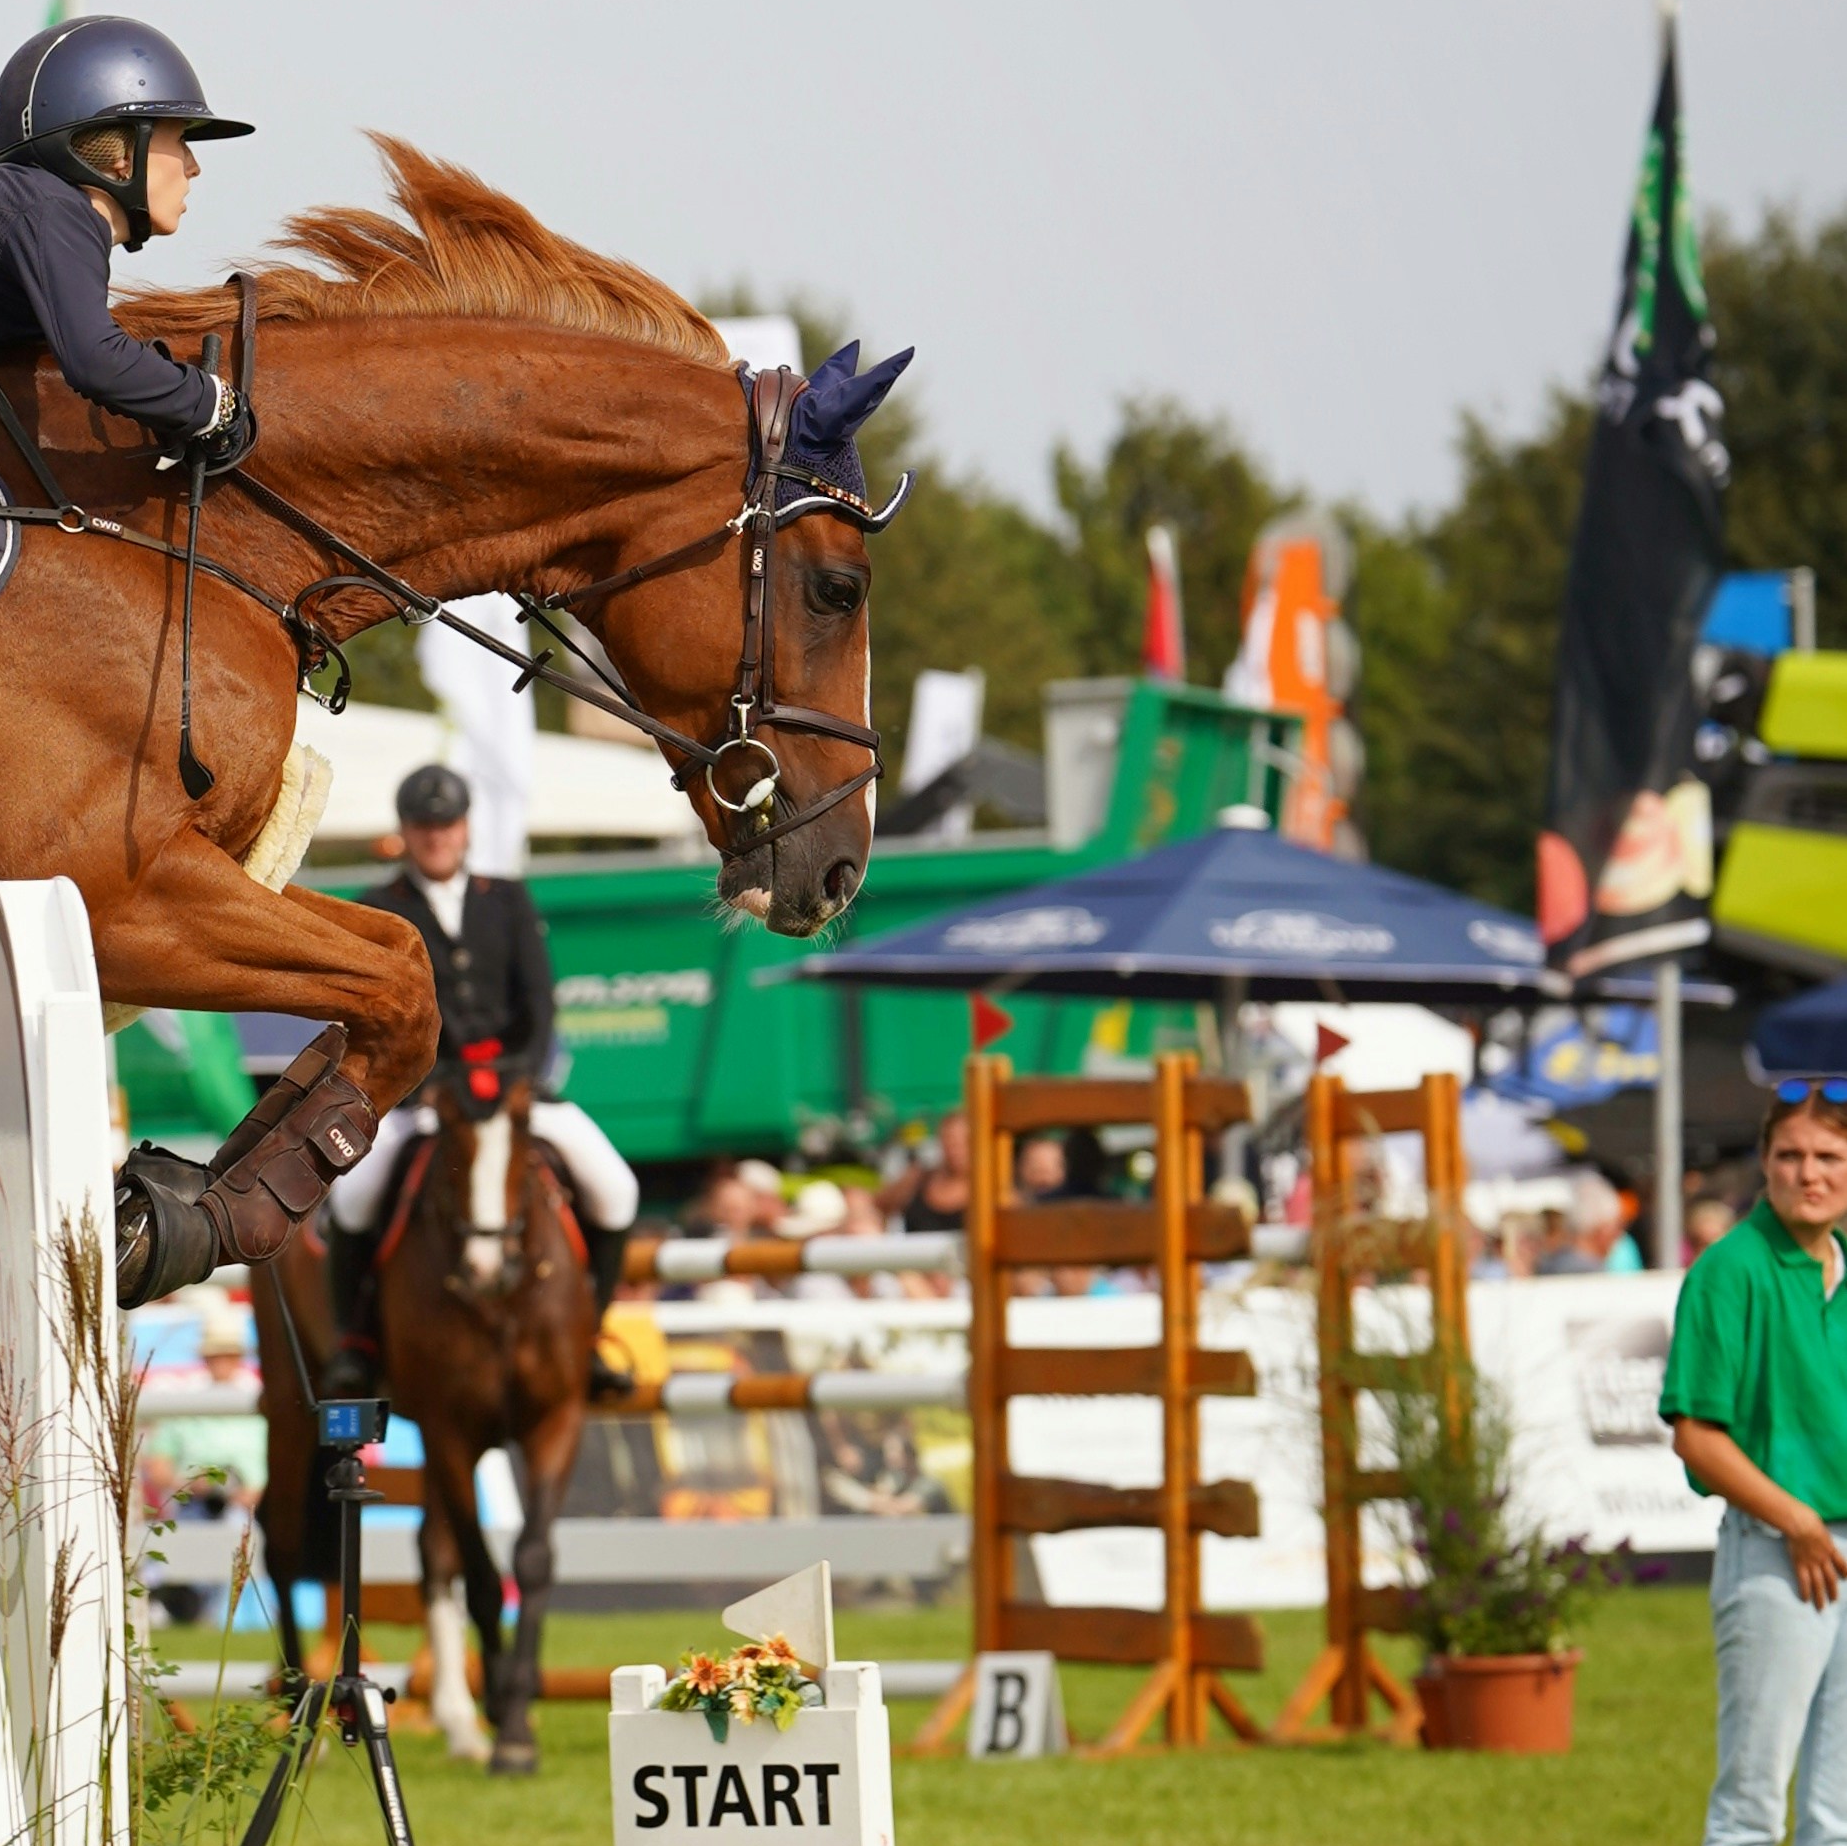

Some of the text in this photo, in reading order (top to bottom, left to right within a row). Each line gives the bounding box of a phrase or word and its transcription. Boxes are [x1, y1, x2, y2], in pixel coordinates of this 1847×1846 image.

[92, 517, 122, 532] CWD
[752, 548, 764, 571] CWD
[329, 1128, 355, 1157] CWD
[985, 1671, 1027, 1753] B
[633, 1764, 840, 1828] START
